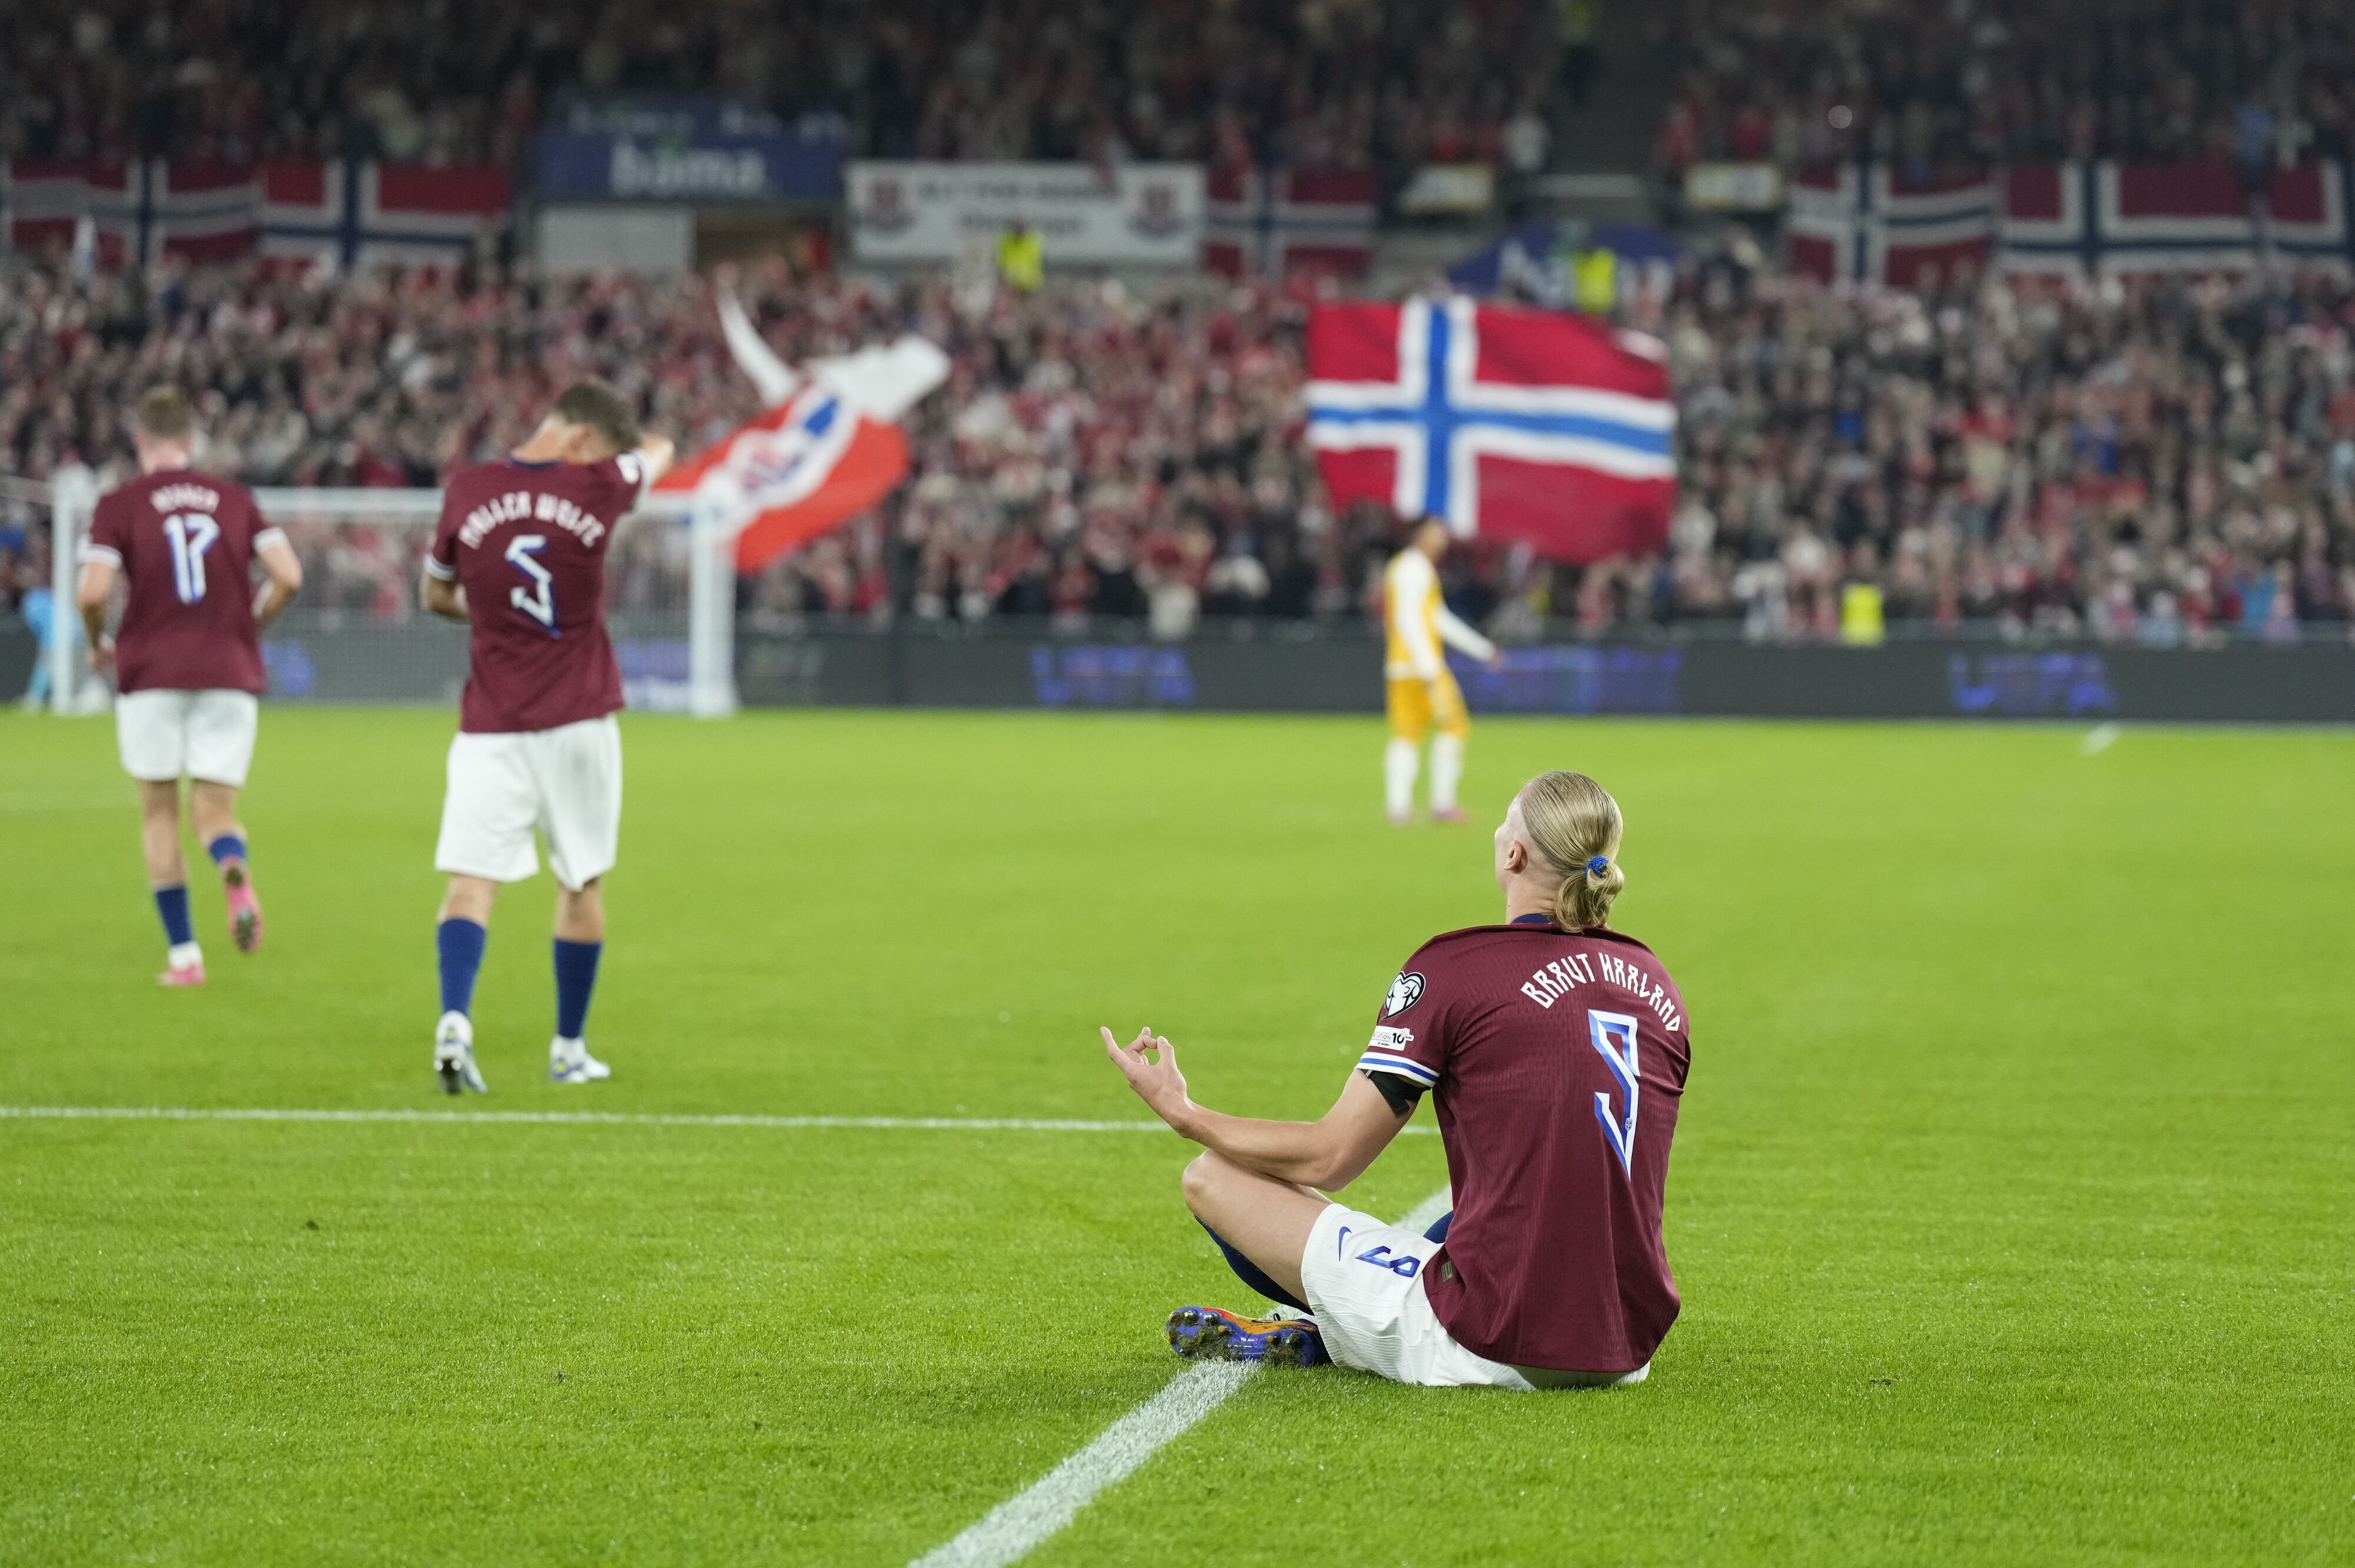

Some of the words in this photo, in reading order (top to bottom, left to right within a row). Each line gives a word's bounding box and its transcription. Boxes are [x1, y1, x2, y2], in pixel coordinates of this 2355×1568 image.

[164, 513, 220, 604] 17
[535, 492, 605, 547] WOLFE
[505, 534, 562, 639] 5
[1521, 954, 1596, 1009] BRAUT
[1598, 952, 1681, 1031] HAALAND
[1392, 1032, 1405, 1044] 10
[1588, 1009, 1641, 1182] 9
[1355, 1245, 1421, 1278] 9
